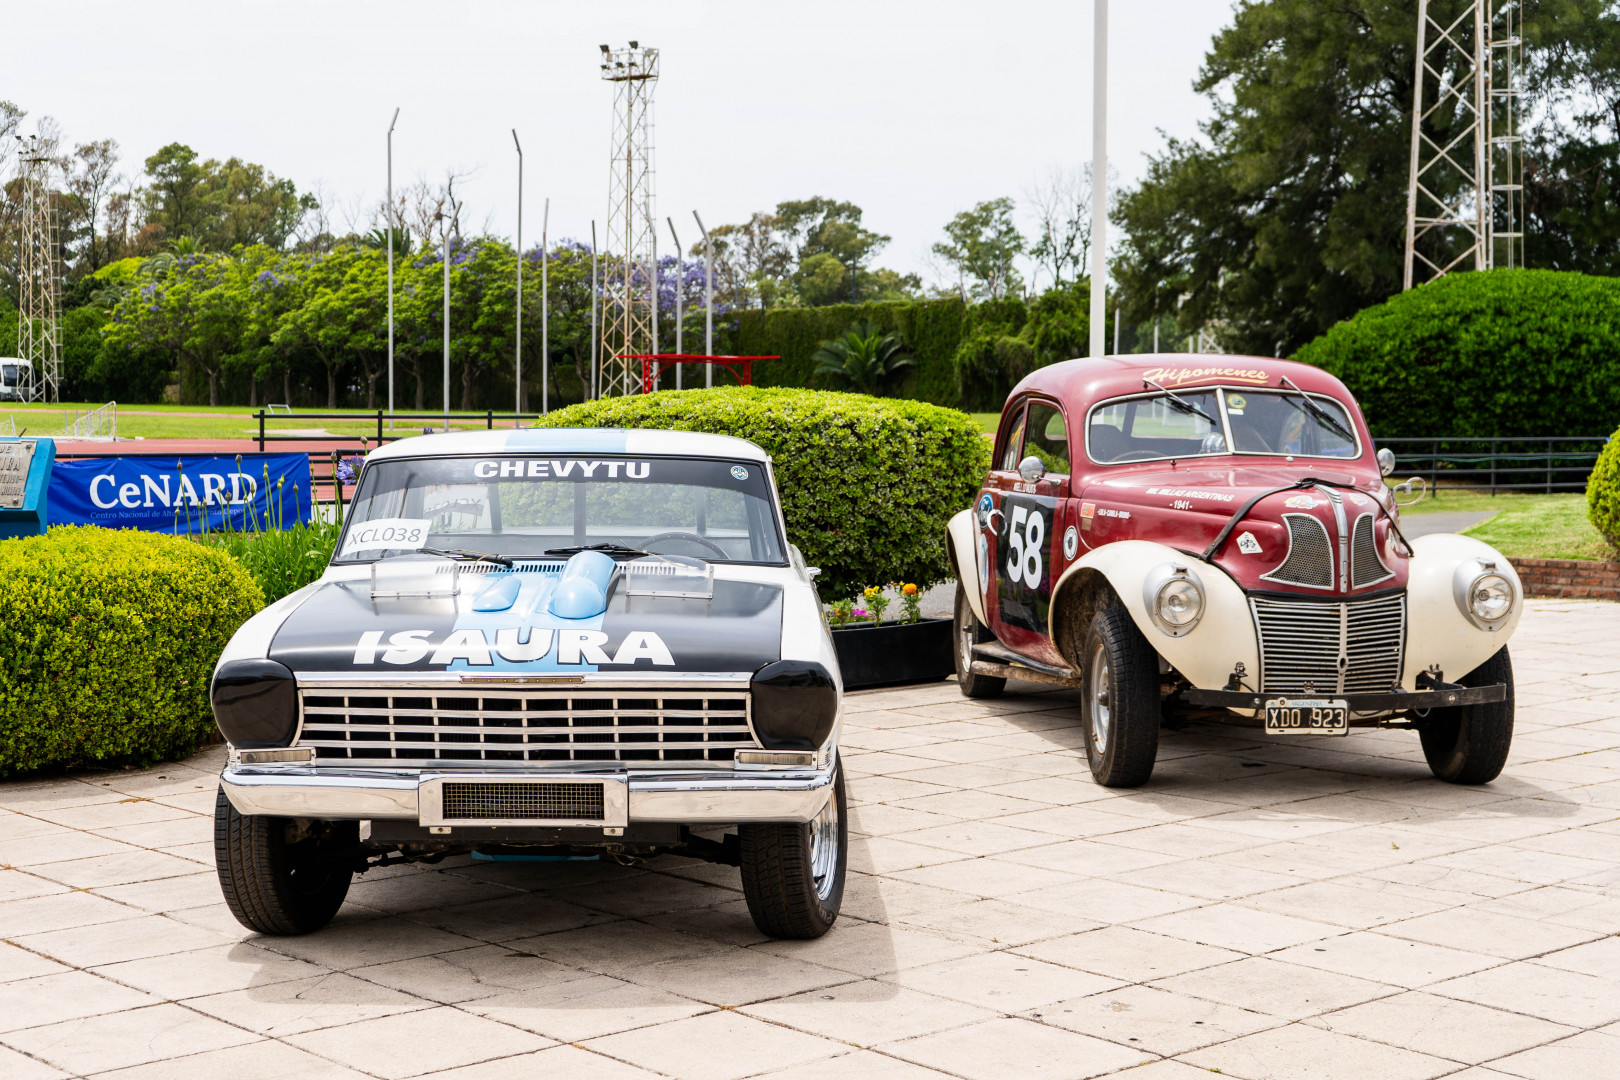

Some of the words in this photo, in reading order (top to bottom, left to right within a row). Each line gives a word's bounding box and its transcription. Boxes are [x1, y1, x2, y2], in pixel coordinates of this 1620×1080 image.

[1143, 367, 1269, 384] Hipomenes
[474, 460, 651, 479] CHEVYTU
[89, 473, 258, 509] CeNARD
[1184, 490, 1234, 501] ARGENTINAS
[90, 511, 117, 519] Centro
[119, 510, 152, 518] Nacional
[162, 509, 176, 517] Alto
[348, 527, 421, 547] XCL038
[1007, 505, 1045, 590] 58
[353, 626, 676, 666] ISAURA
[1270, 709, 1300, 727] XDO
[1312, 709, 1343, 727] 923
